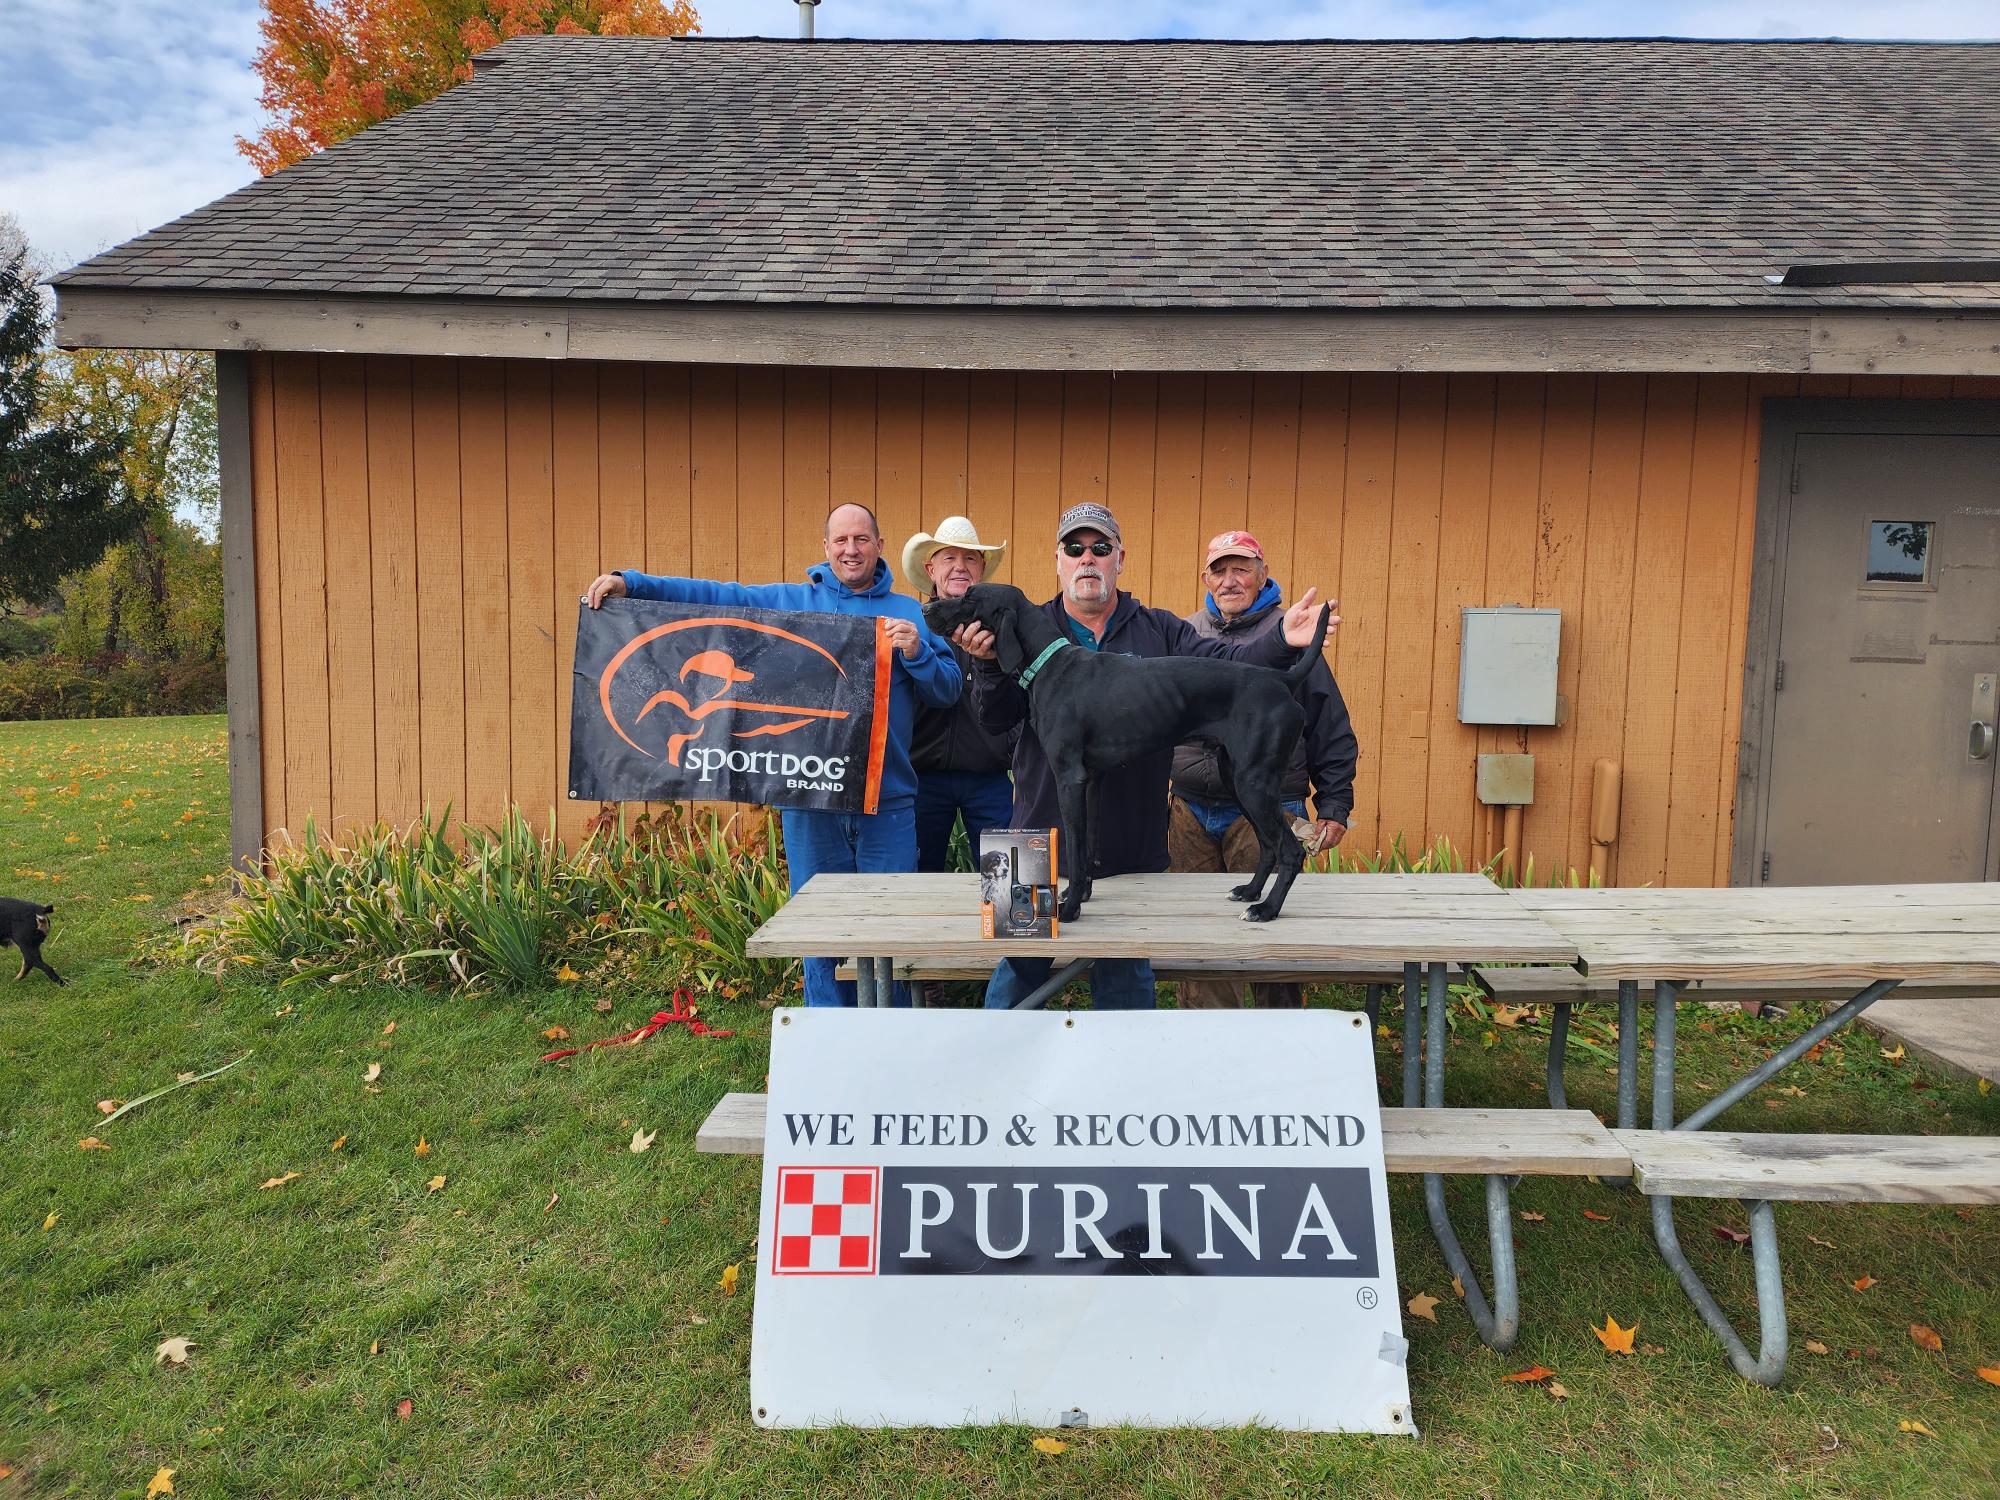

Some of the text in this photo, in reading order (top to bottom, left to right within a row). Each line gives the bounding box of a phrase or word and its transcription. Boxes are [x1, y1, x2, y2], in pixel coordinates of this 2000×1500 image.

[786, 778, 844, 792] BRAND
[784, 1113, 1366, 1148] WE FEED & RECOMMEND
[899, 1182, 1358, 1261] PURINA
